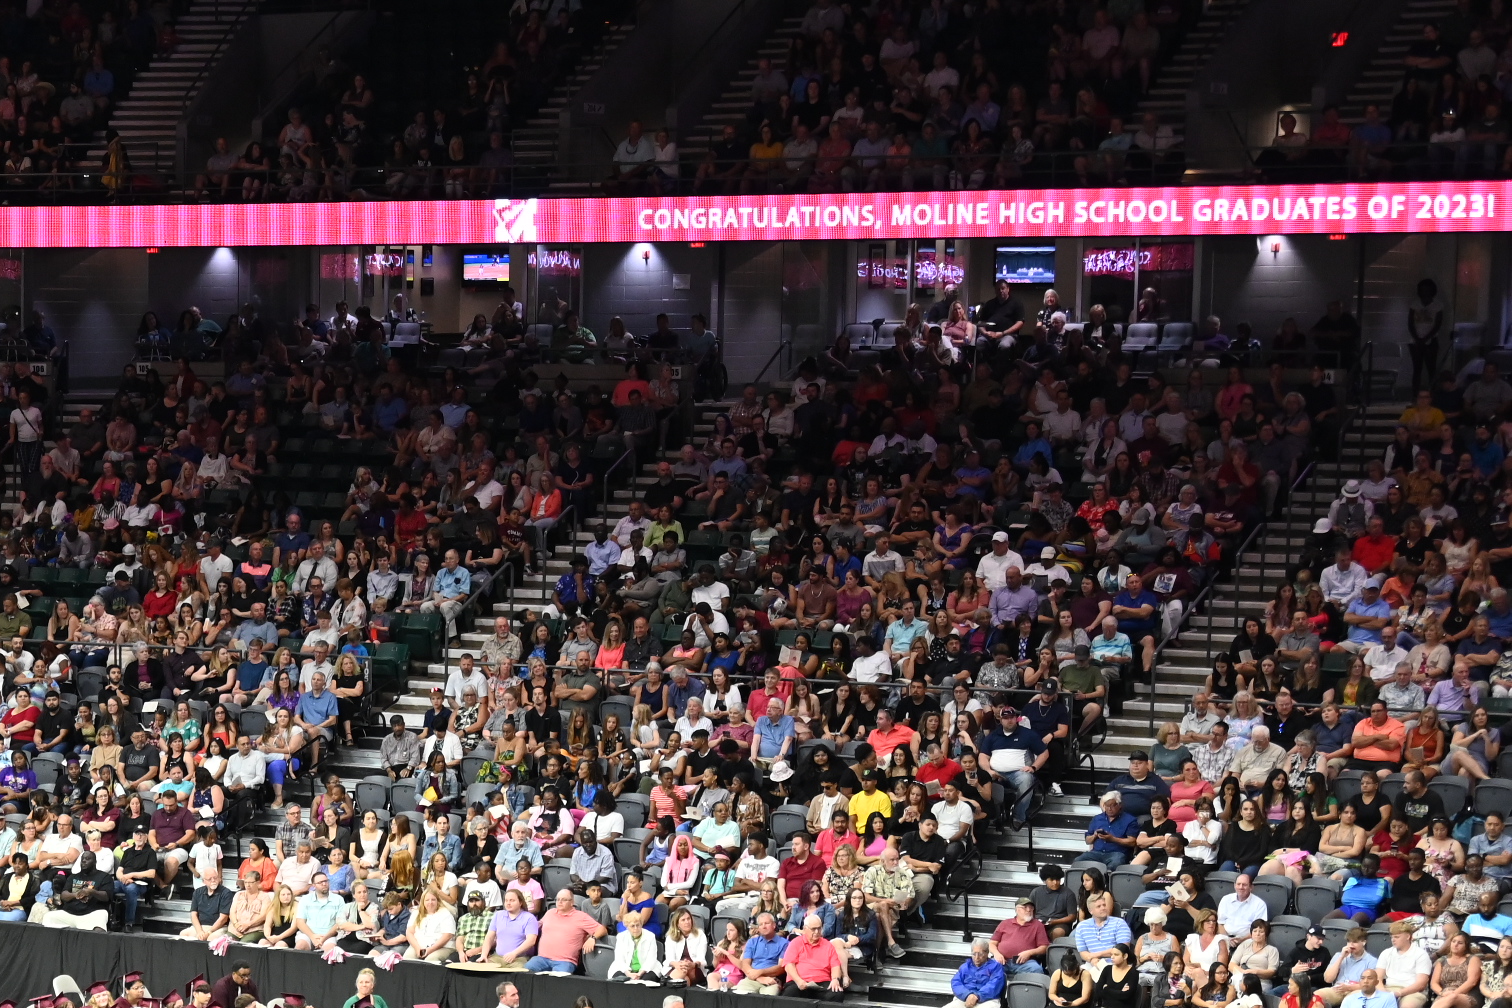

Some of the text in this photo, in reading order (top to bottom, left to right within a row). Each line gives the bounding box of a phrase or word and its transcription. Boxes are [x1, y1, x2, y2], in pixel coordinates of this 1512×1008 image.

[638, 194, 1494, 230] CONGRATULATIONS, MOLINE HIGH SCHOOL GRADUATES OF 2023!
[32, 365, 45, 373] 106
[138, 365, 149, 373] 105
